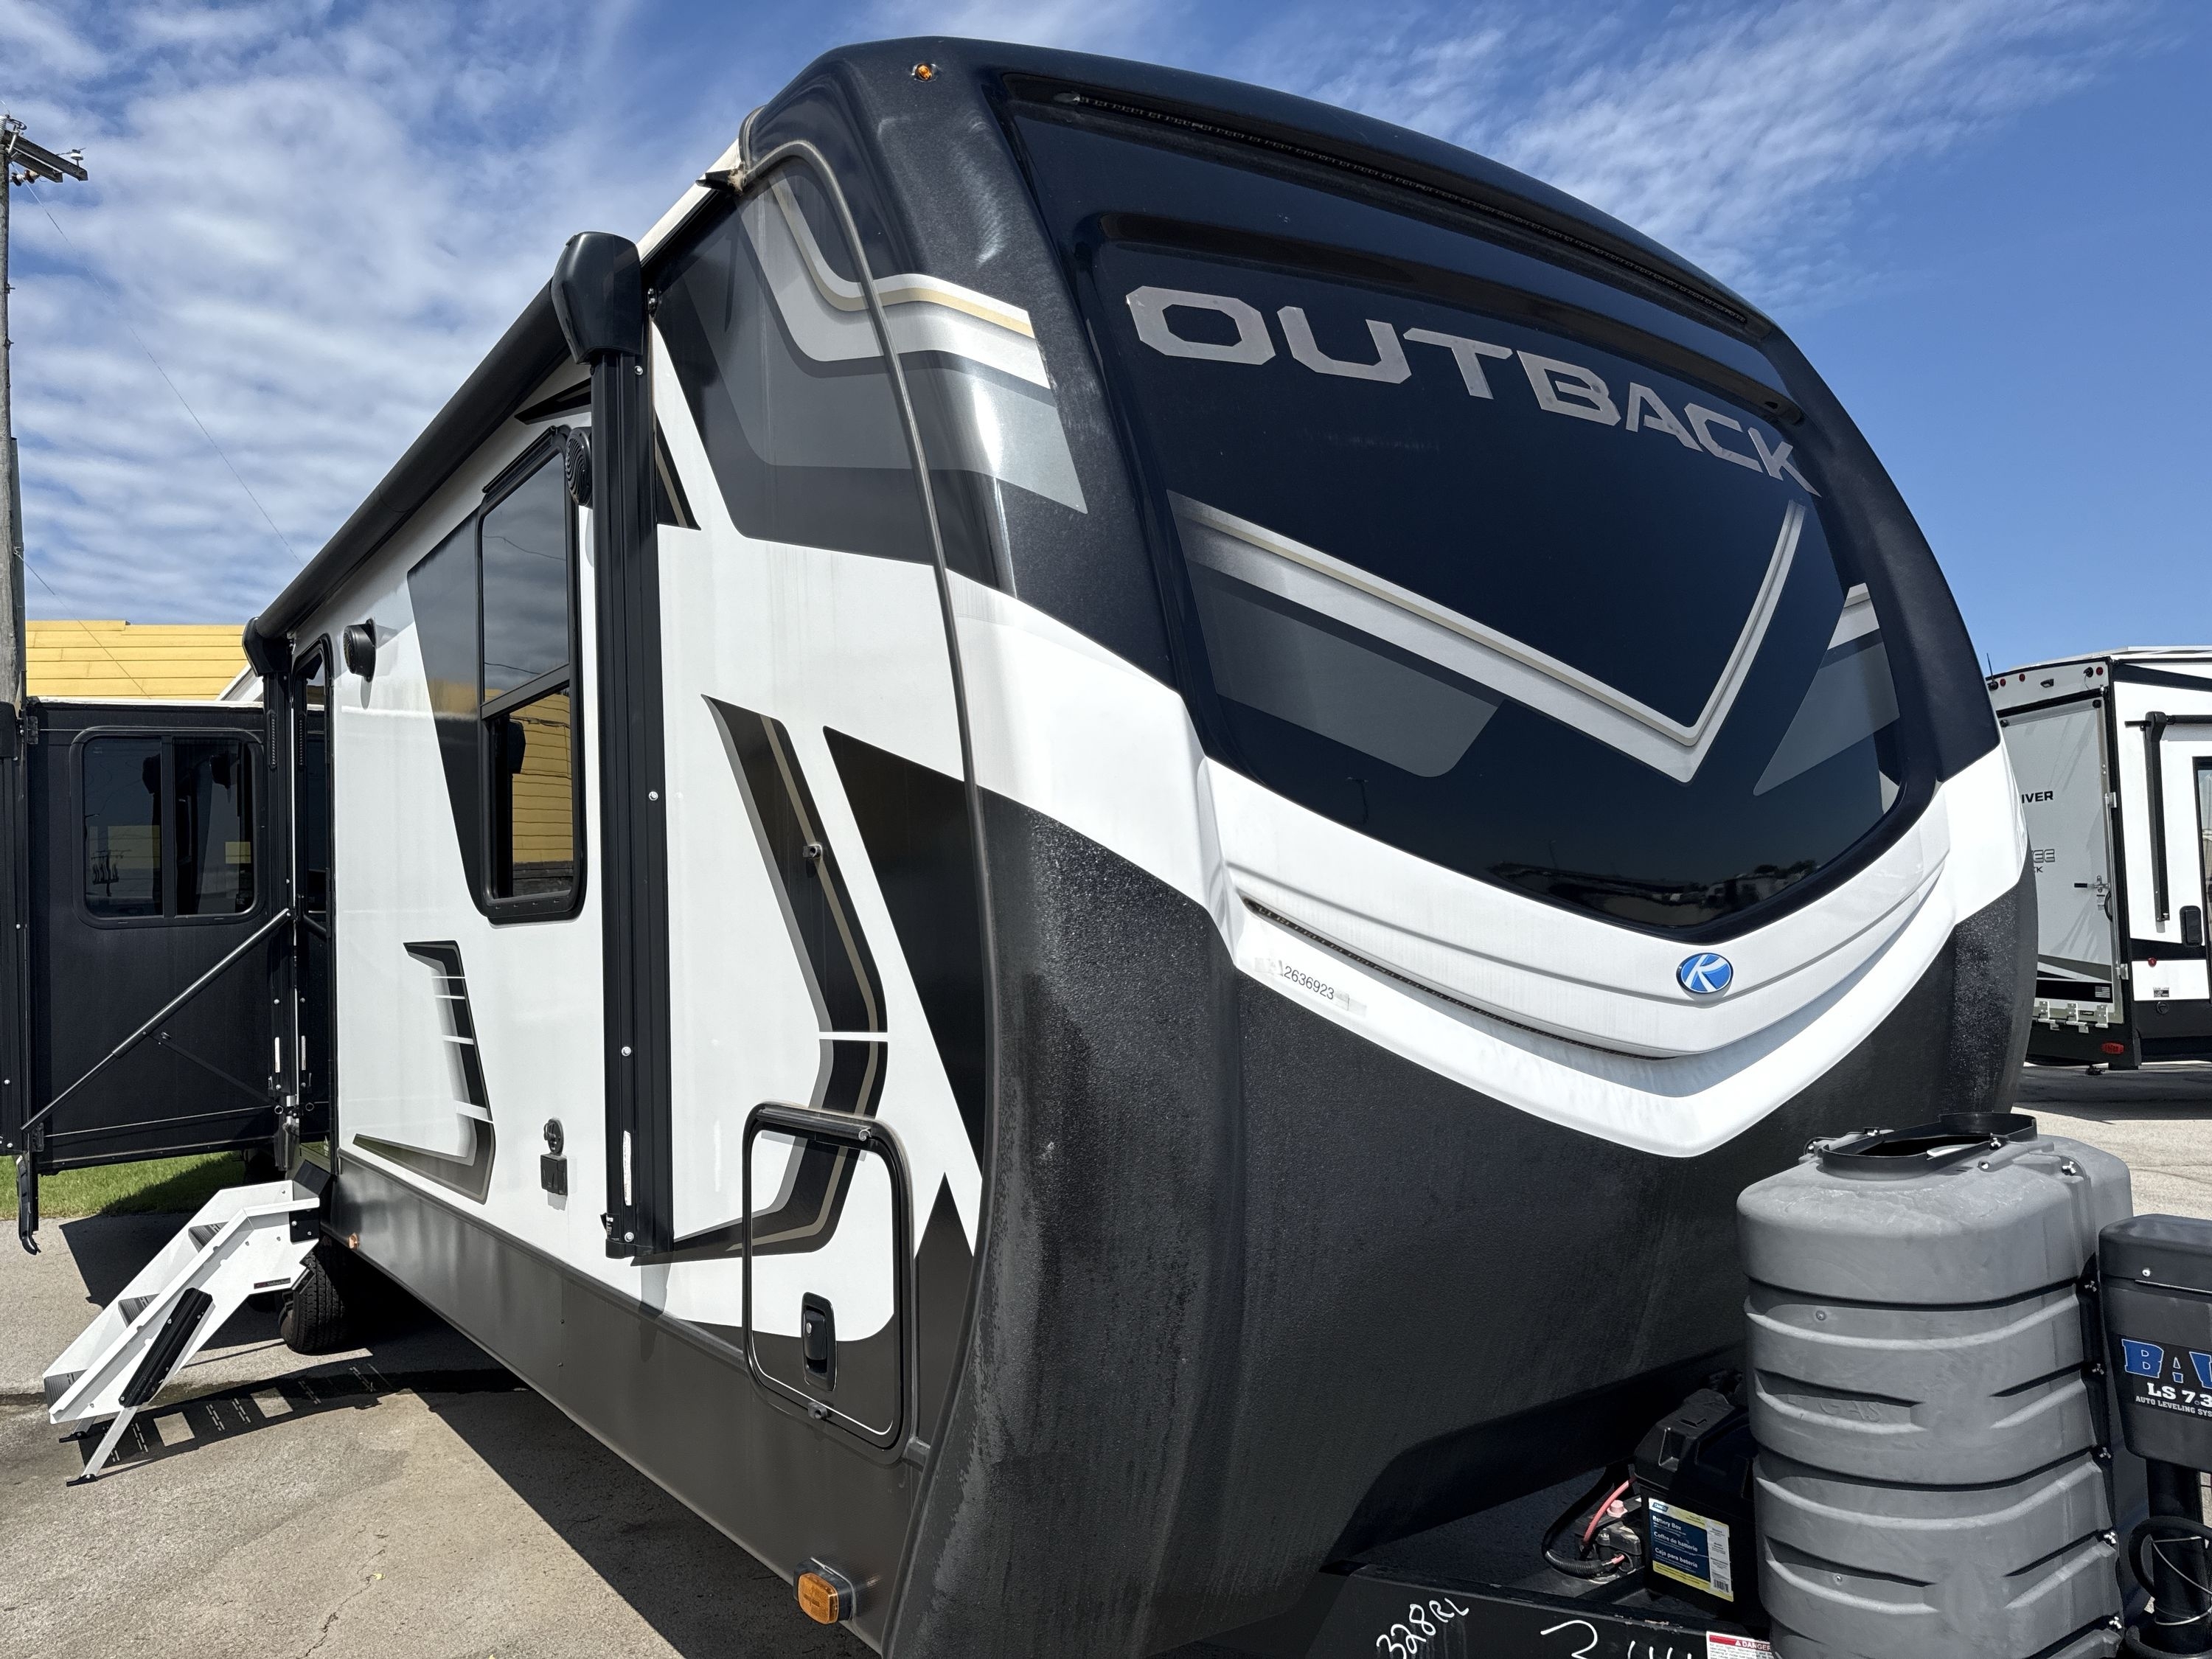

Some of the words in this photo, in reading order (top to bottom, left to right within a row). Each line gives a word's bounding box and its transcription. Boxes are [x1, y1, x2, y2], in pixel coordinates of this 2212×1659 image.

[1126, 286, 1820, 497] OUTBACK
[2031, 849, 2055, 863] EE
[2147, 1382, 2177, 1400] LS
[2135, 1396, 2156, 1405] AUTO
[2157, 1400, 2196, 1414] LEVELING
[1671, 1522, 1682, 1531] Box
[1742, 1640, 1771, 1651] DANGER
